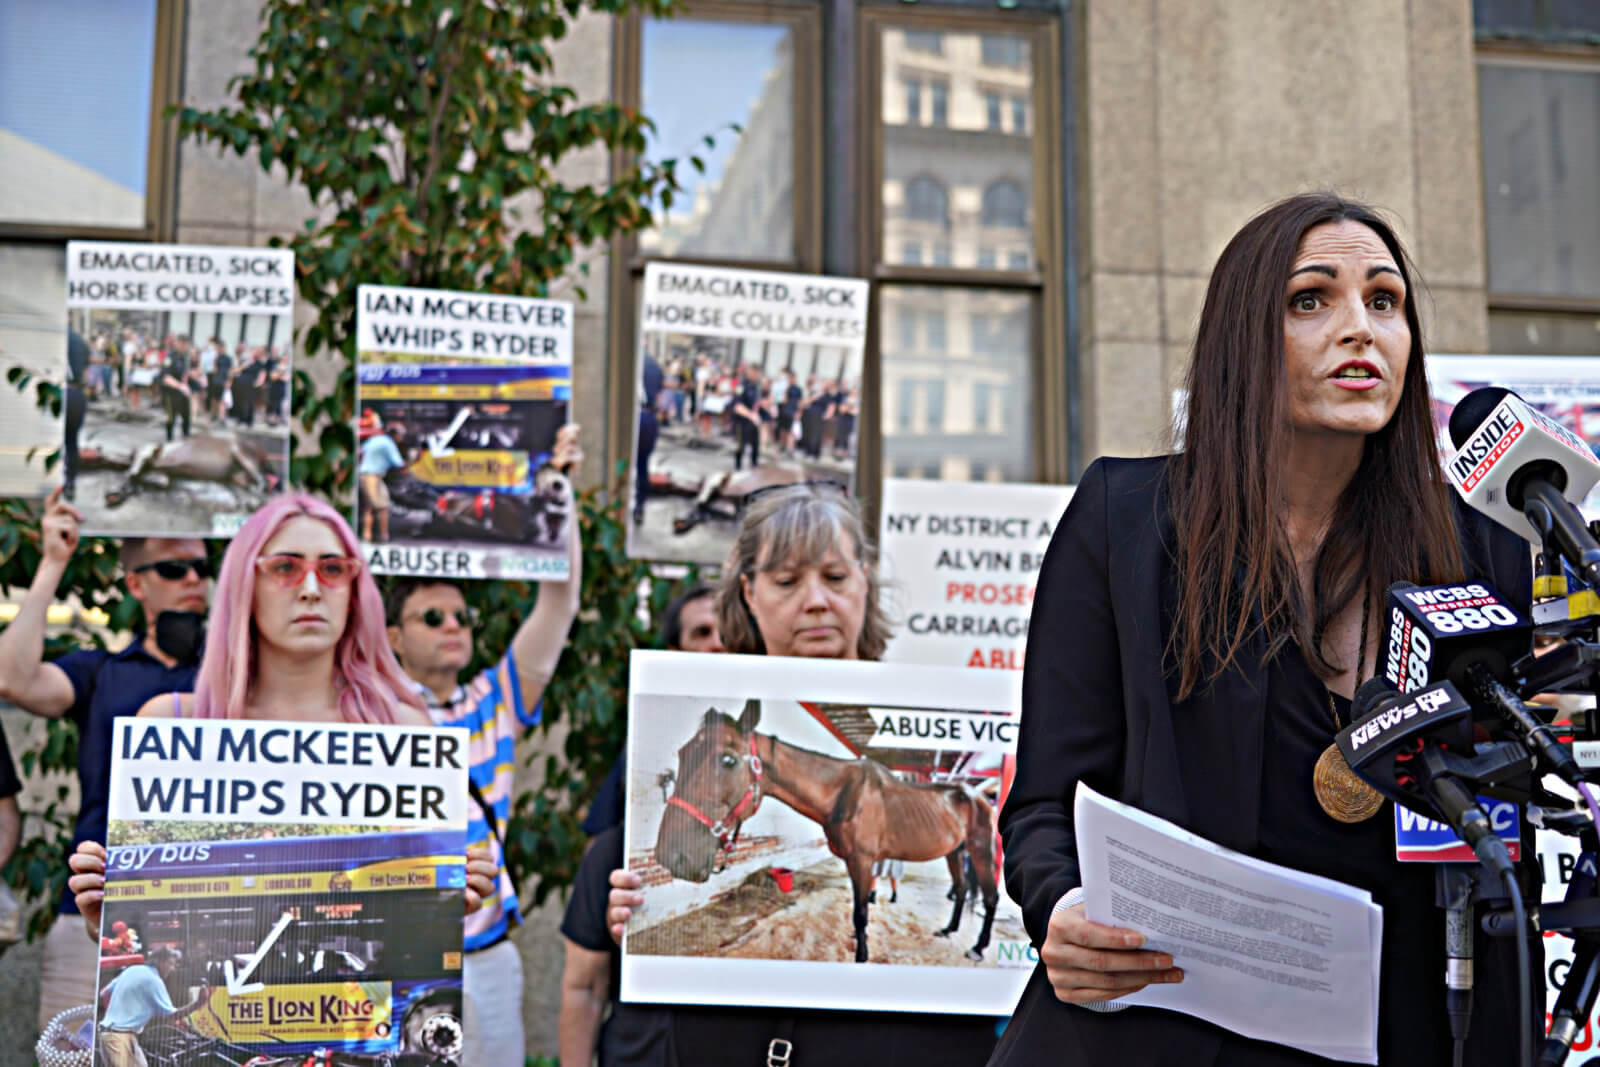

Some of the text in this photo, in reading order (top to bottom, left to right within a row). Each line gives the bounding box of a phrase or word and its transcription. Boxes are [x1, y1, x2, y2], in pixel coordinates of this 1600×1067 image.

[79, 251, 282, 277] EMACIATED, SICK
[69, 281, 291, 307] HORSE COLLAPSES
[658, 273, 856, 308] EMACIATED, SICK
[366, 292, 566, 328] IAN MCKEEVER
[647, 303, 864, 338] HORSE COLLAPSES
[373, 324, 558, 358] WHIPS RYDER
[1454, 408, 1514, 479] INSIDE
[1467, 425, 1522, 487] EDITION
[888, 515, 920, 533] NY
[927, 516, 1030, 538] DISTRICT
[370, 550, 470, 573] ABUSER
[936, 549, 1012, 571] ALVIN
[1405, 584, 1489, 605] WCBS
[1419, 597, 1498, 612] NEWSRADIO
[1426, 604, 1518, 632] 880
[1386, 607, 1405, 685] WCBS
[878, 716, 961, 739] ABUSE
[1351, 703, 1418, 750] NEWS
[122, 725, 462, 769] IAN MCKEEVER
[131, 777, 448, 820] WHIPS RYDER
[159, 844, 211, 863] bus
[228, 994, 374, 1025] THE LION KING
